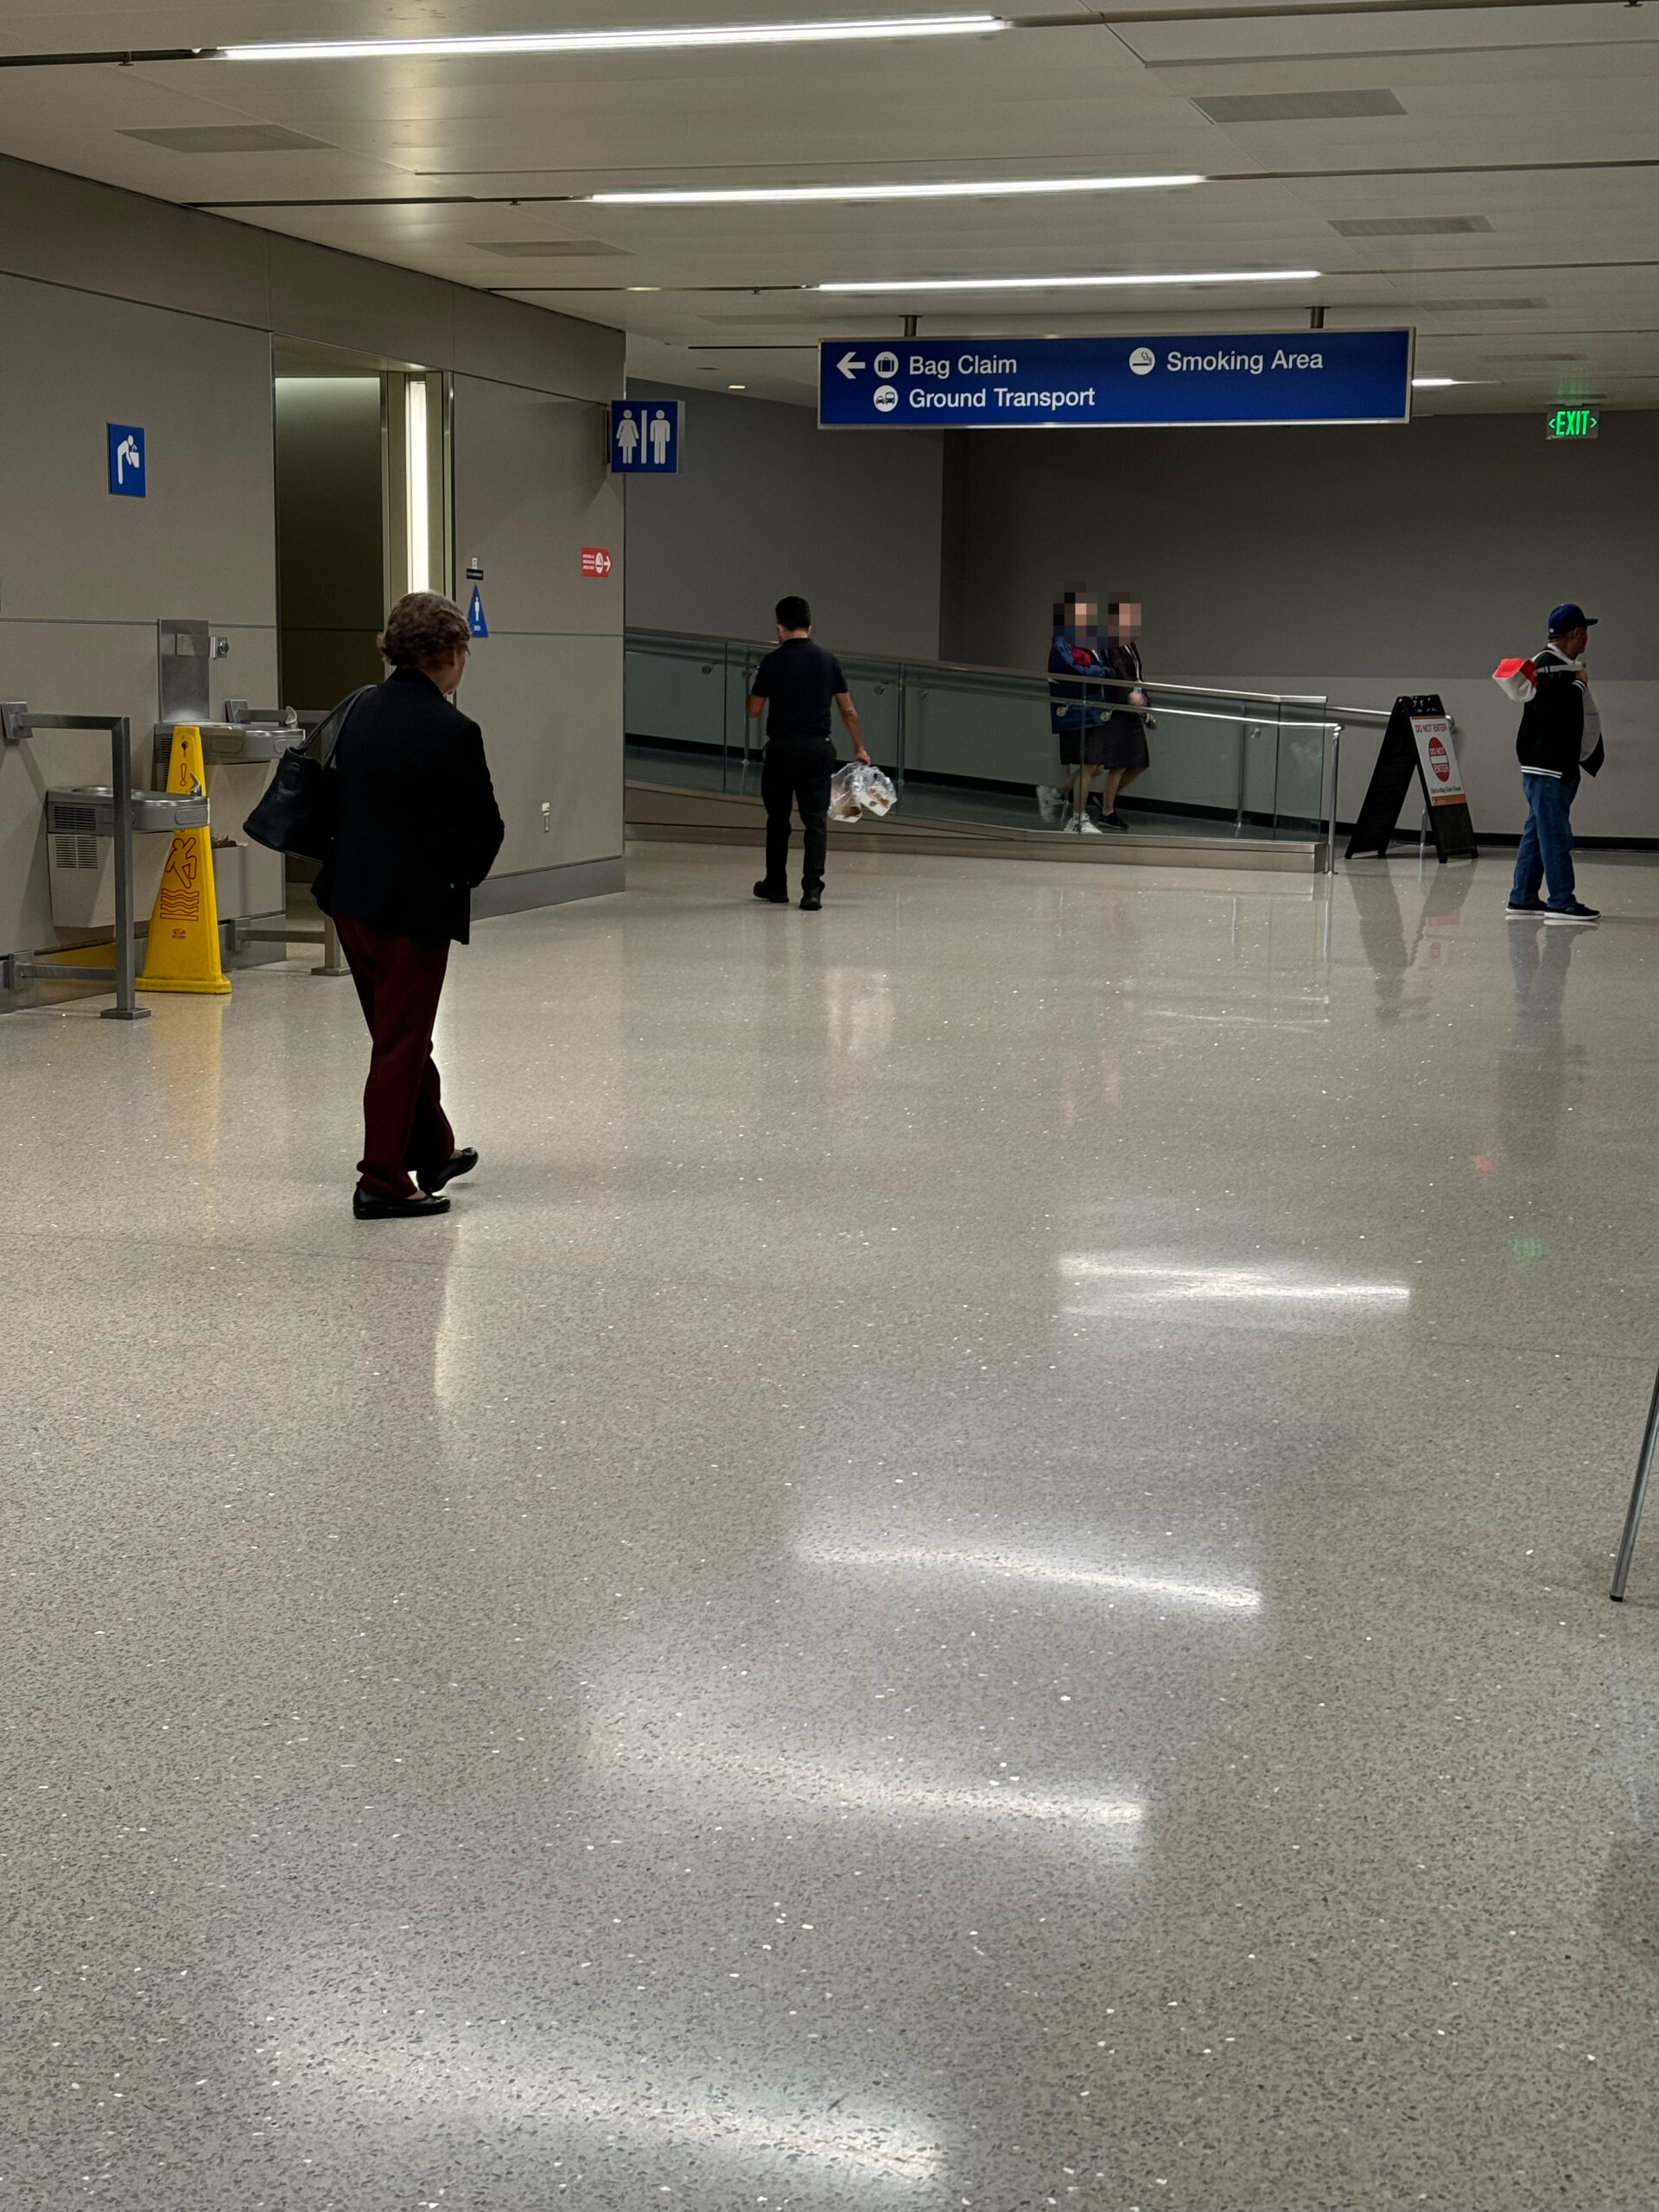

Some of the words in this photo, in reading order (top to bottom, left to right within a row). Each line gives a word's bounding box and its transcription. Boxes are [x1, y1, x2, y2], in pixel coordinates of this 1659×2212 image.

[909, 355, 950, 379] Bag
[957, 354, 1017, 374] Claim
[1166, 350, 1264, 375] Smoking
[1271, 348, 1324, 370] Area
[909, 387, 986, 409] Ground
[994, 387, 1096, 411] Transport
[1556, 410, 1590, 435] EXIT
